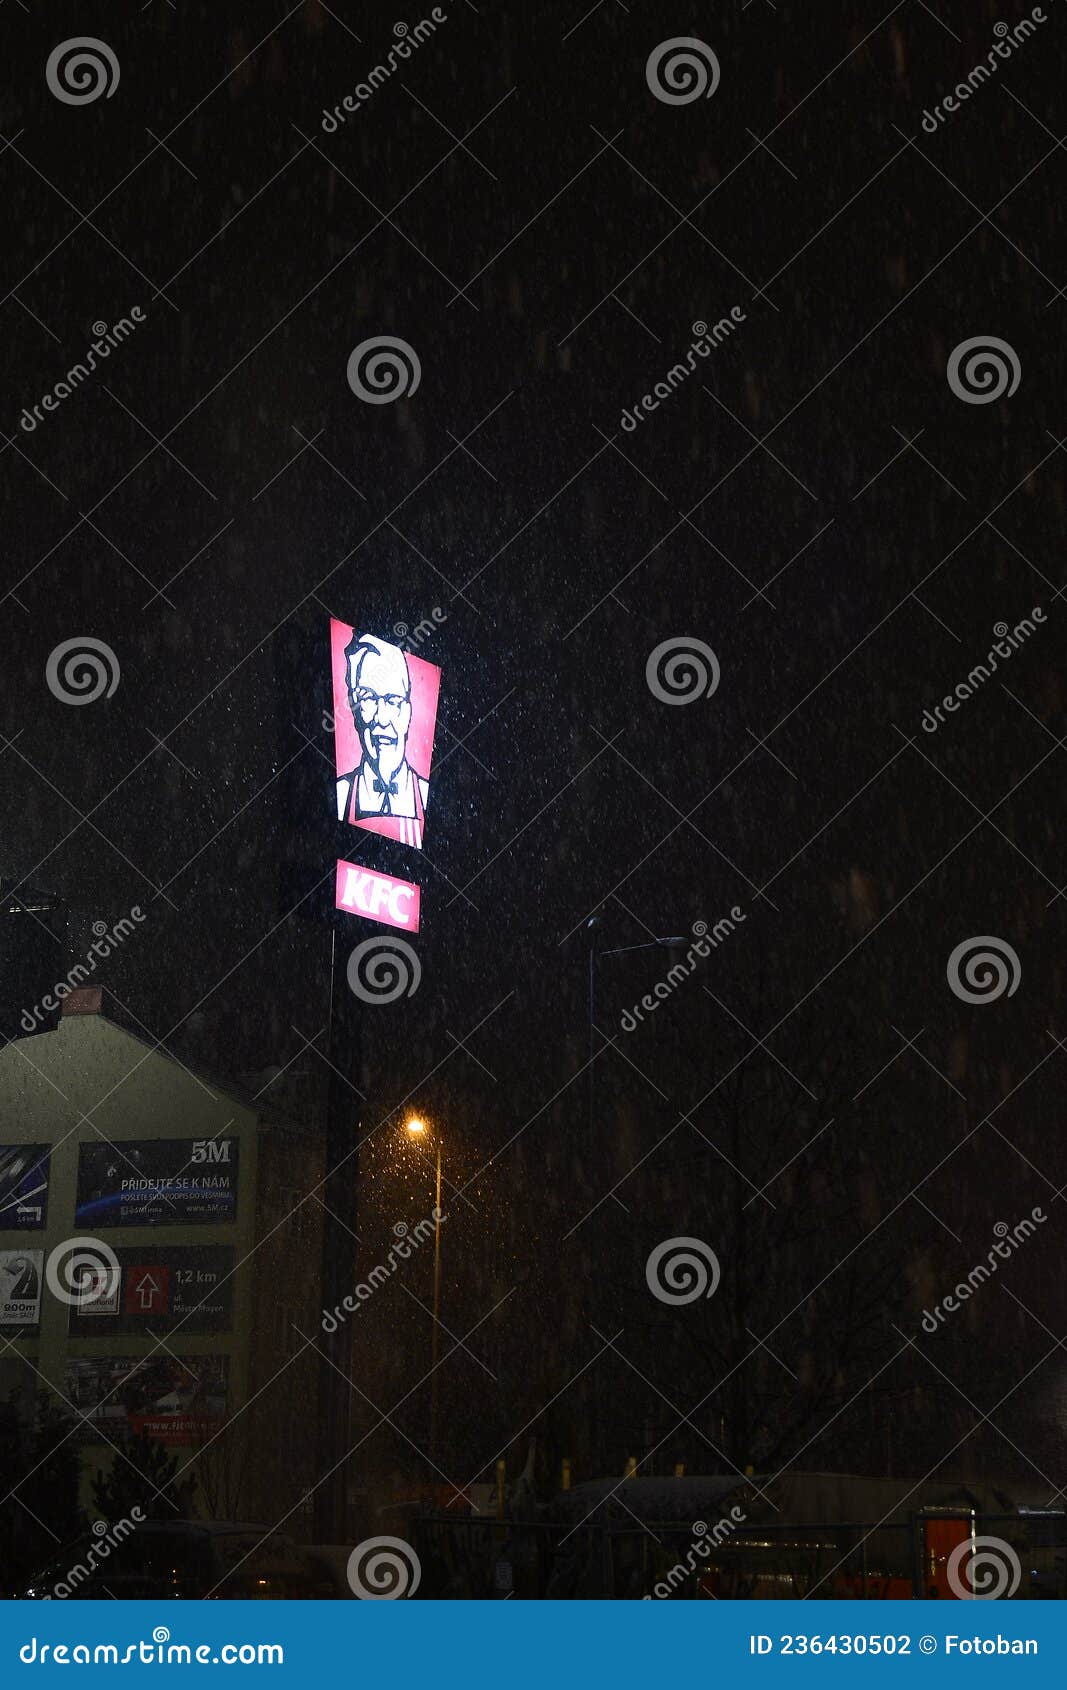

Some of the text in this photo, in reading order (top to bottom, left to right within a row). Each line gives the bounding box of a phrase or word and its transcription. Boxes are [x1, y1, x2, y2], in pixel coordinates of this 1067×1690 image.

[341, 867, 412, 924] KFC
[191, 1140, 231, 1163] 5M
[121, 1175, 230, 1190] PŘIDEJTE SE K NÁM
[176, 1270, 216, 1284] 1,2 km
